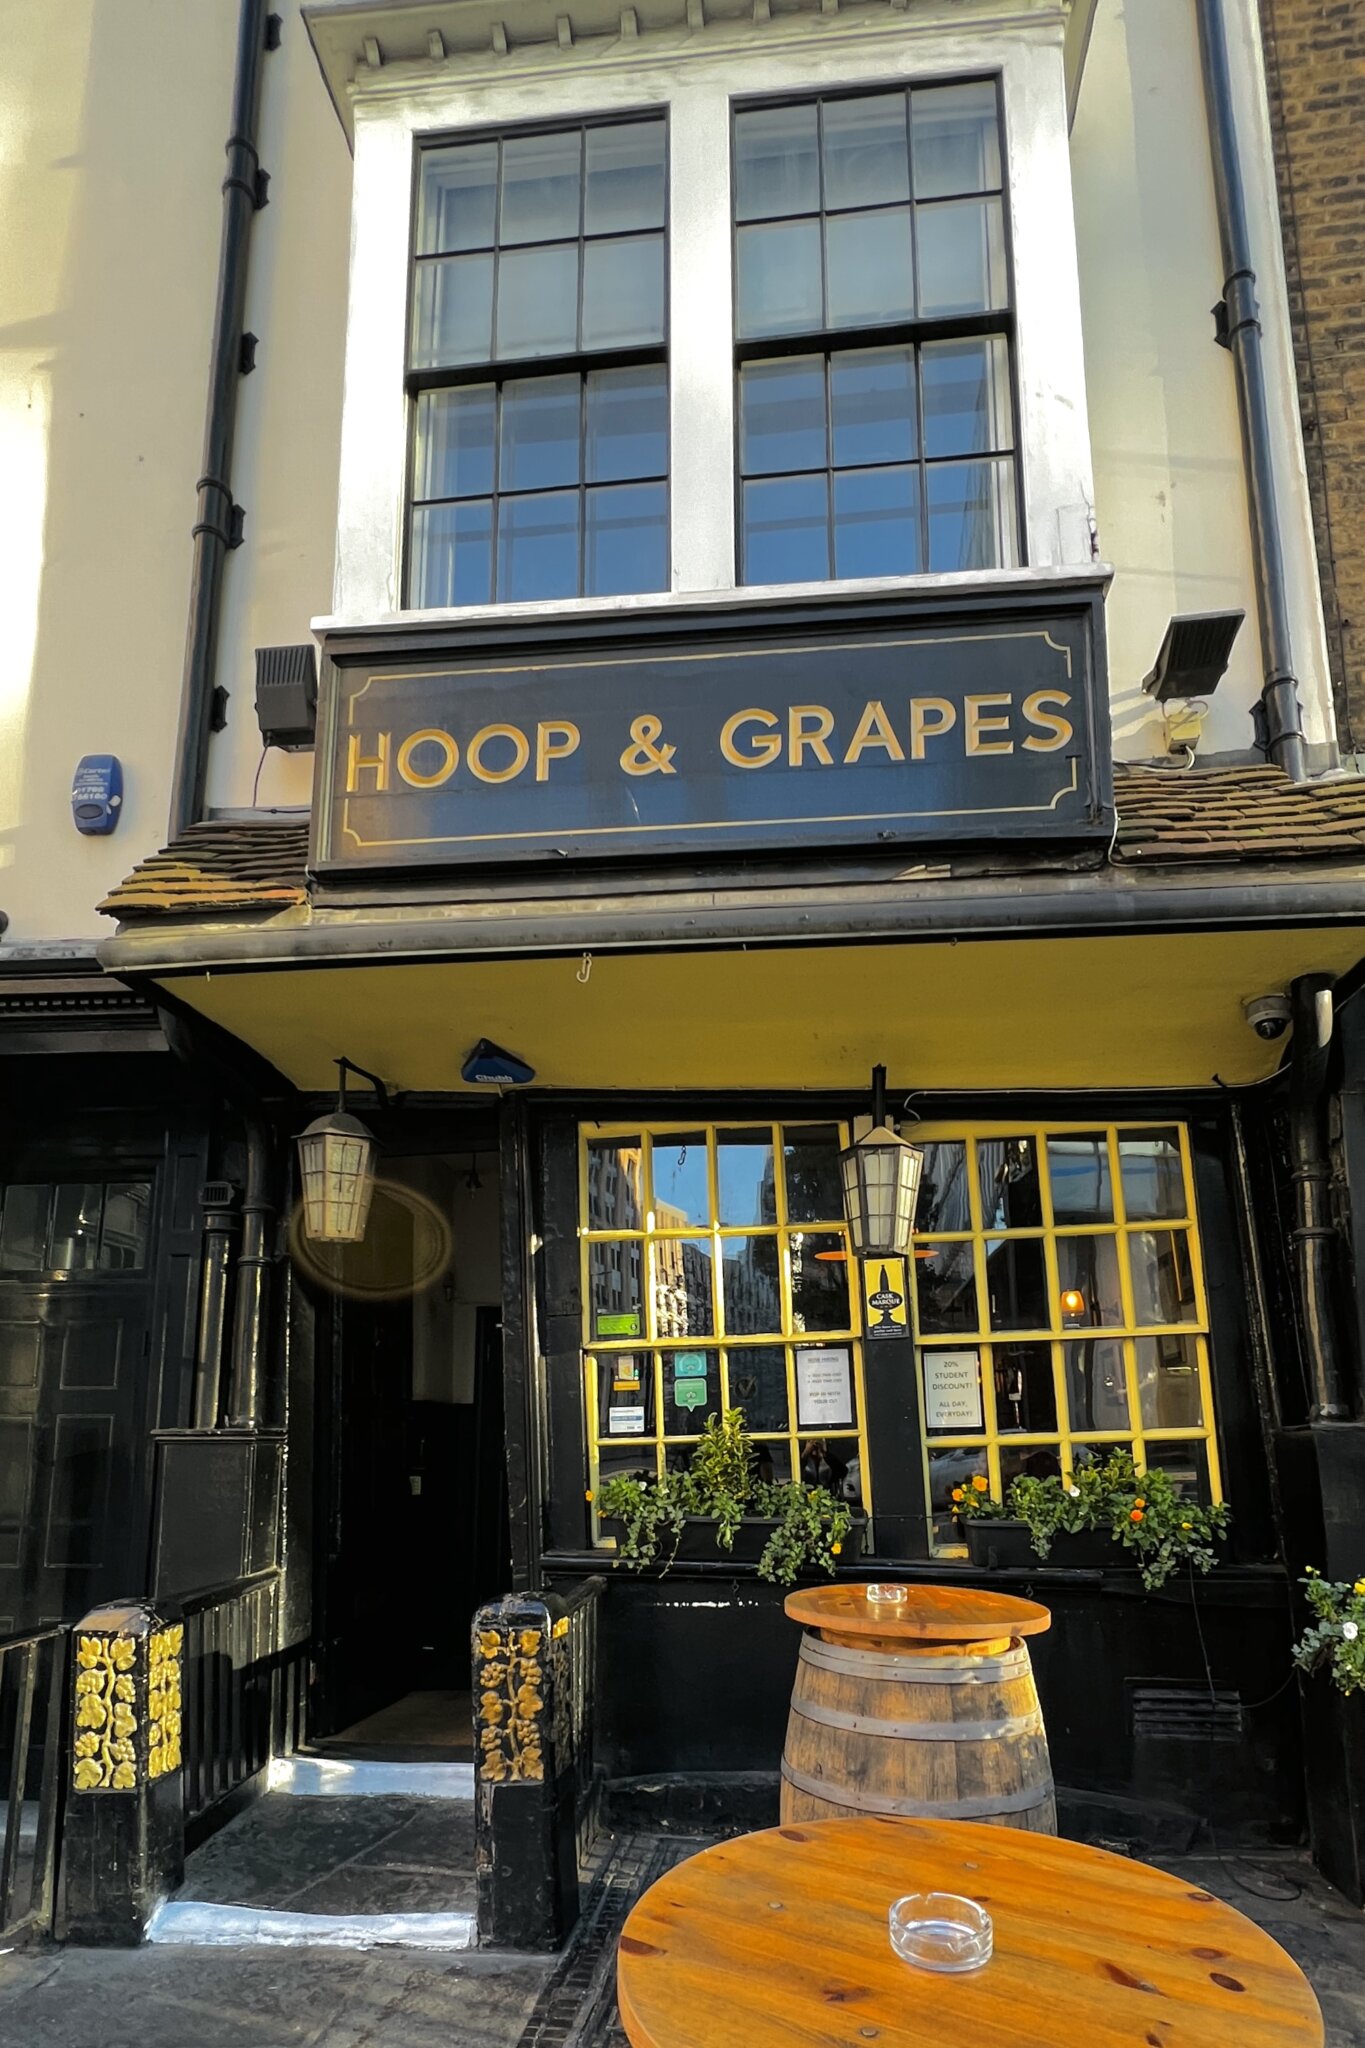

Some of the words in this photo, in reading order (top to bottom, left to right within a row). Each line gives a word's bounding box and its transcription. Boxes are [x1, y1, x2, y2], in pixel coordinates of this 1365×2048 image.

[346, 721, 581, 792] HOOP
[620, 714, 677, 776] &
[720, 690, 1073, 769] GRAPES
[475, 1074, 513, 1082] Chubb
[871, 1298, 900, 1306] MARQUE
